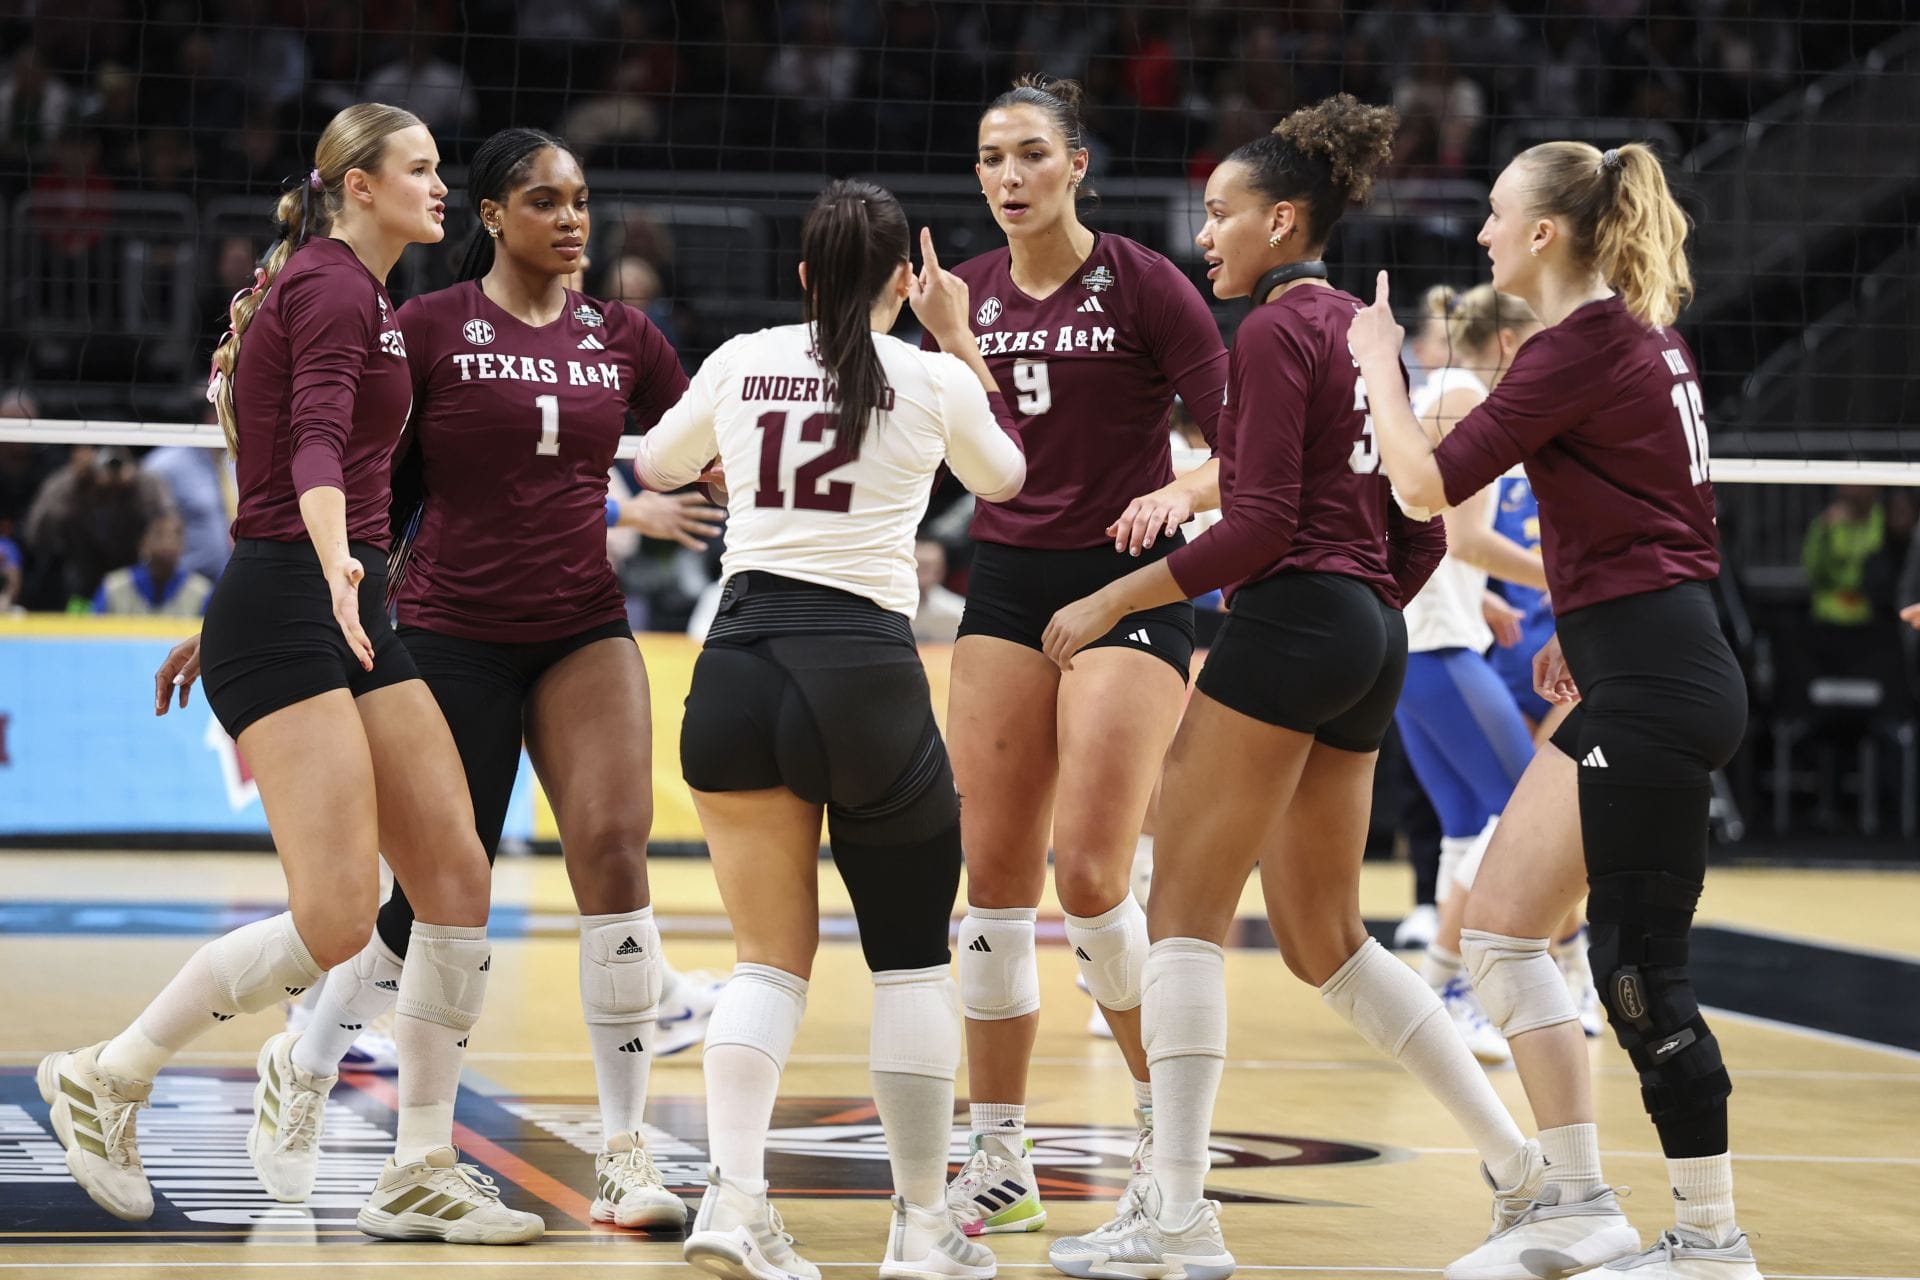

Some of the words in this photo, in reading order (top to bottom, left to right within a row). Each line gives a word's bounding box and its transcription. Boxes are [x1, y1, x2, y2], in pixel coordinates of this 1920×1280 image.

[978, 299, 1000, 325] SEC
[465, 320, 493, 344] SEC
[1054, 326, 1115, 352] A&M
[453, 353, 558, 384] TEXAS
[567, 361, 620, 390] A&M
[1012, 358, 1051, 415] 9
[535, 394, 560, 456] 1
[754, 411, 861, 513] 12
[617, 946, 643, 955] adidas
